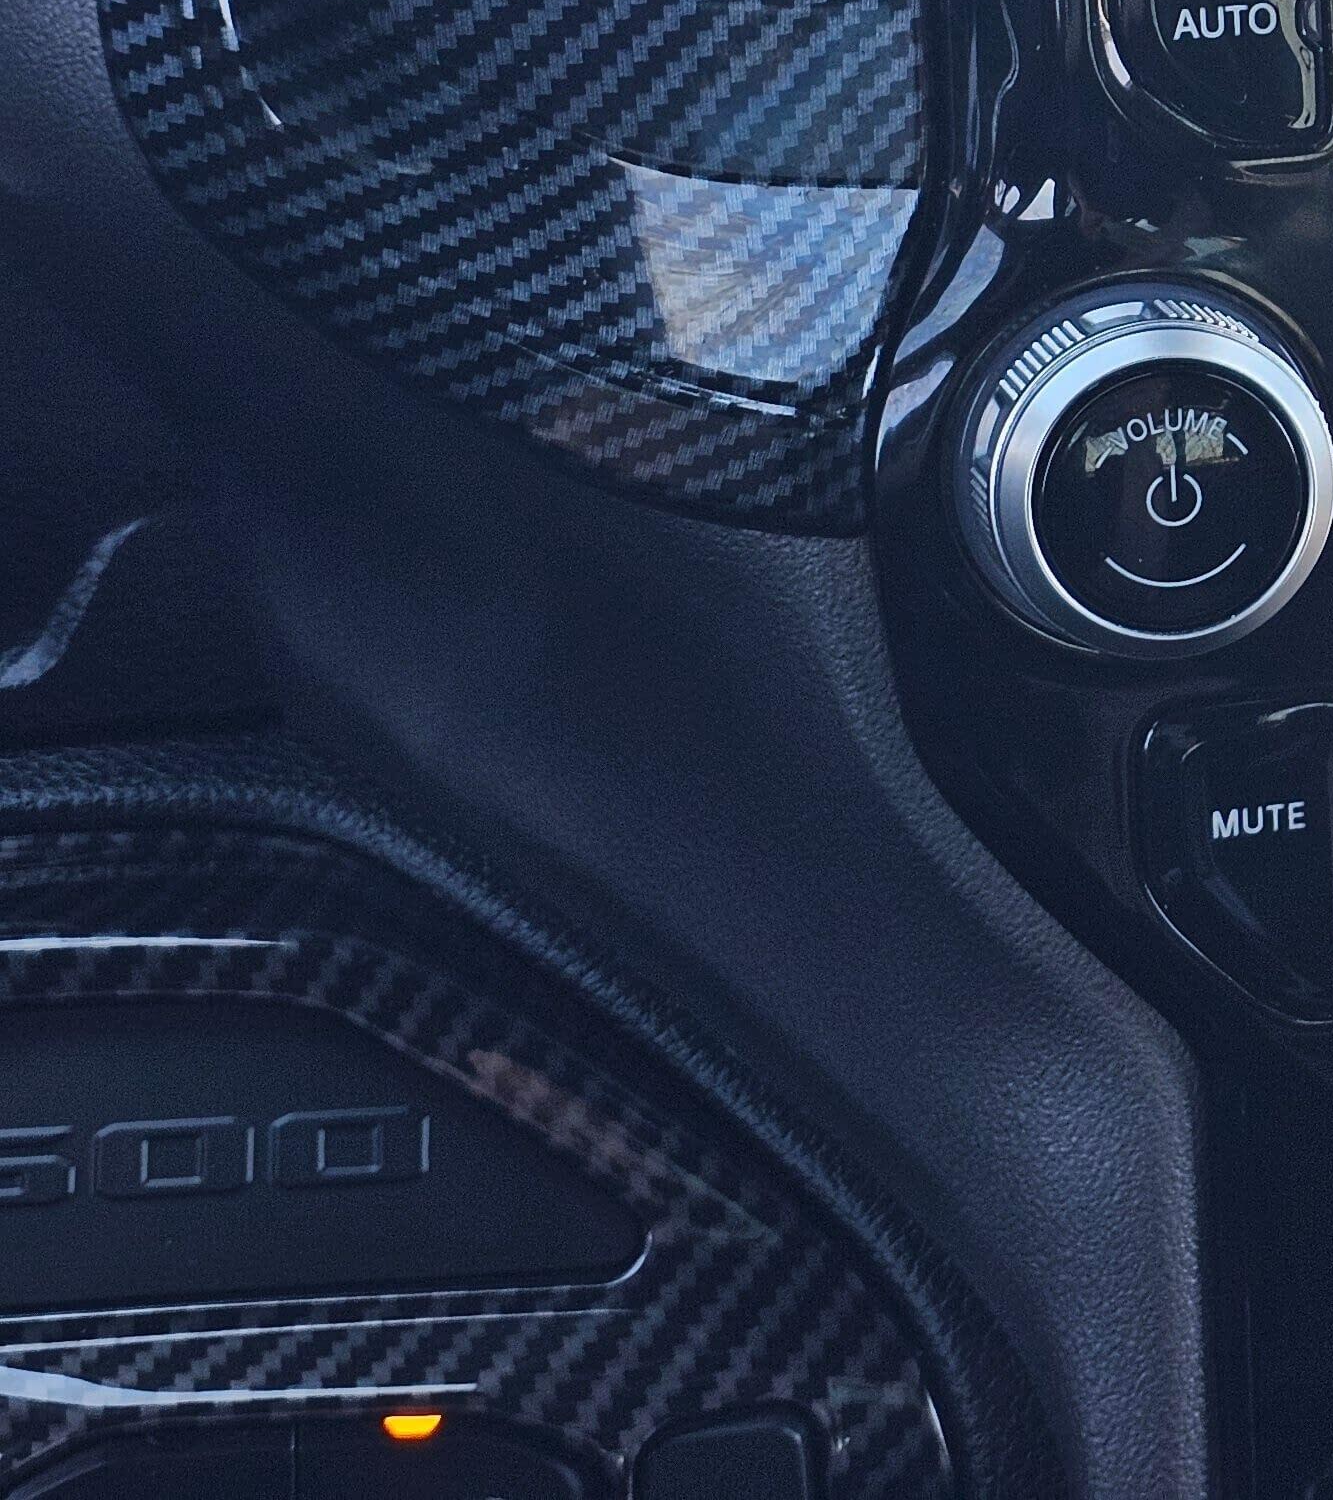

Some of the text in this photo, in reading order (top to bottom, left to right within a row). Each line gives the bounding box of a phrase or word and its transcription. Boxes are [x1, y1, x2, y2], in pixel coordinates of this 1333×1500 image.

[1172, 2, 1278, 41] AUTO
[1110, 407, 1228, 451] VOLUME
[1212, 801, 1306, 839] MUTE
